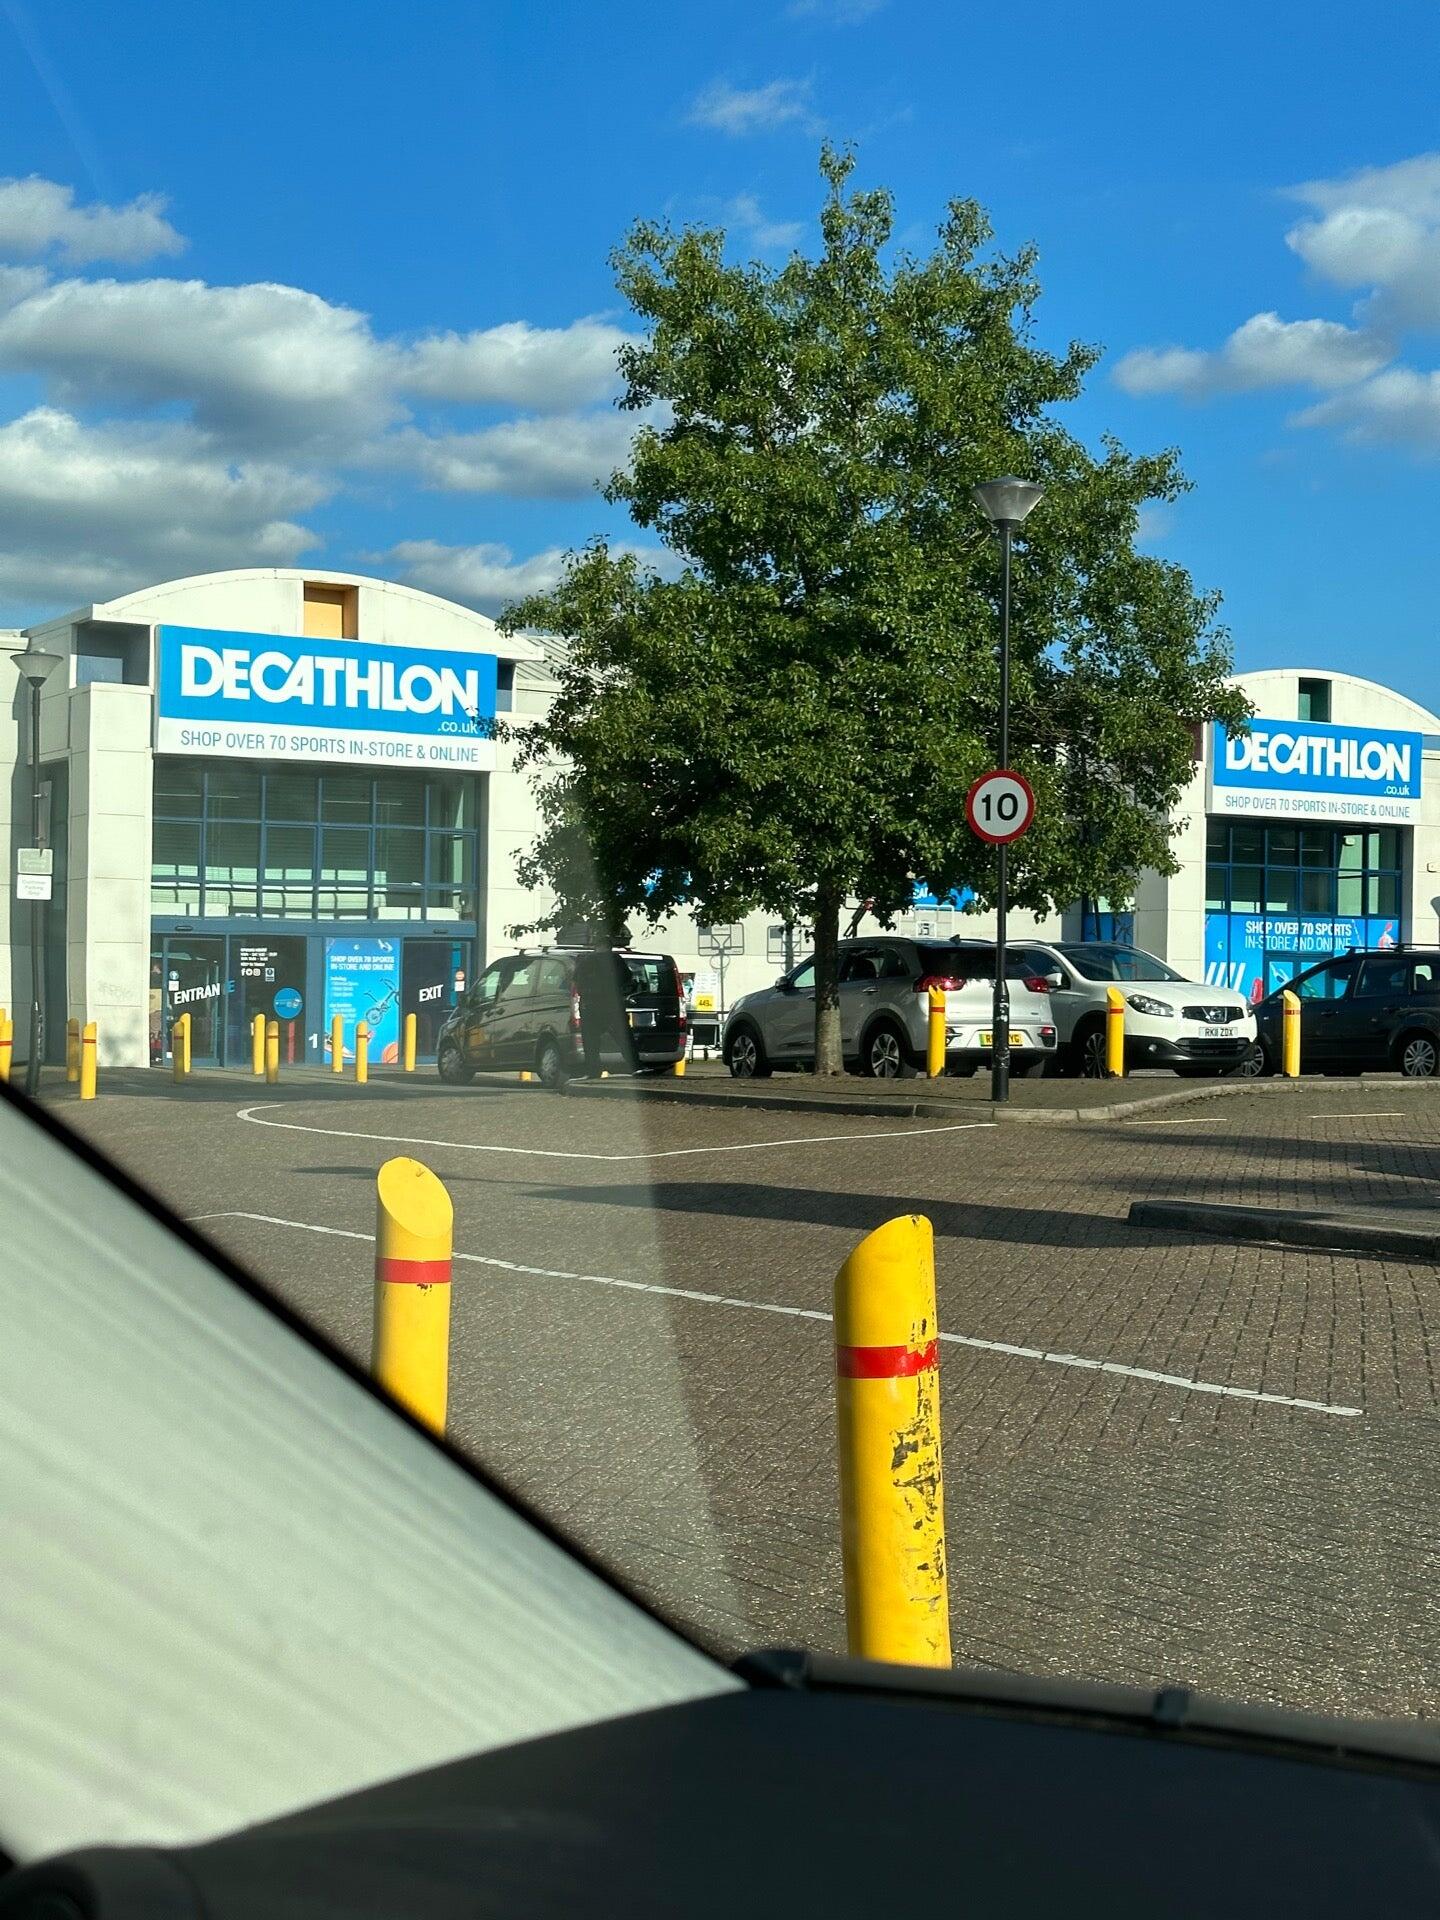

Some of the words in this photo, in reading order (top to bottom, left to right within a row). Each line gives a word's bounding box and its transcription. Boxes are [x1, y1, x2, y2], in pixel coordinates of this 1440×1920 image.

[181, 644, 479, 717] DECATHLON
[437, 720, 479, 735] .co.uk
[180, 730, 222, 747] SHOP
[225, 732, 265, 750] OVER
[270, 734, 286, 751] 70
[290, 736, 345, 754] SPORTS
[349, 740, 413, 759] IN-STORE
[416, 745, 425, 760] &
[429, 745, 479, 763] ONLINE
[1225, 731, 1411, 783] DECATHLON
[1383, 785, 1410, 796] .co.uk
[981, 793, 1018, 821] 10
[1225, 795, 1251, 808] SHOP
[1252, 797, 1277, 811] OVER
[1279, 798, 1290, 811] 70
[1291, 799, 1327, 814] SPORTS
[1328, 801, 1369, 816] IN-STORE
[1370, 804, 1377, 816] &
[1379, 804, 1410, 819] ONLINE
[1245, 920, 1273, 935] SHOP
[1274, 921, 1299, 935] OVER
[1301, 922, 1314, 936] 70
[1315, 922, 1352, 937] SPORTS
[1245, 935, 1291, 951] IN-STORE
[1293, 936, 1314, 952] AND
[331, 955, 347, 963] SHOP
[347, 955, 364, 963] OVER
[372, 956, 395, 964] SPORTS
[372, 963, 394, 971] ONLINE
[174, 980, 236, 1005] ENTRANE
[419, 984, 444, 1002] EXIT
[308, 1033, 318, 1049] 1
